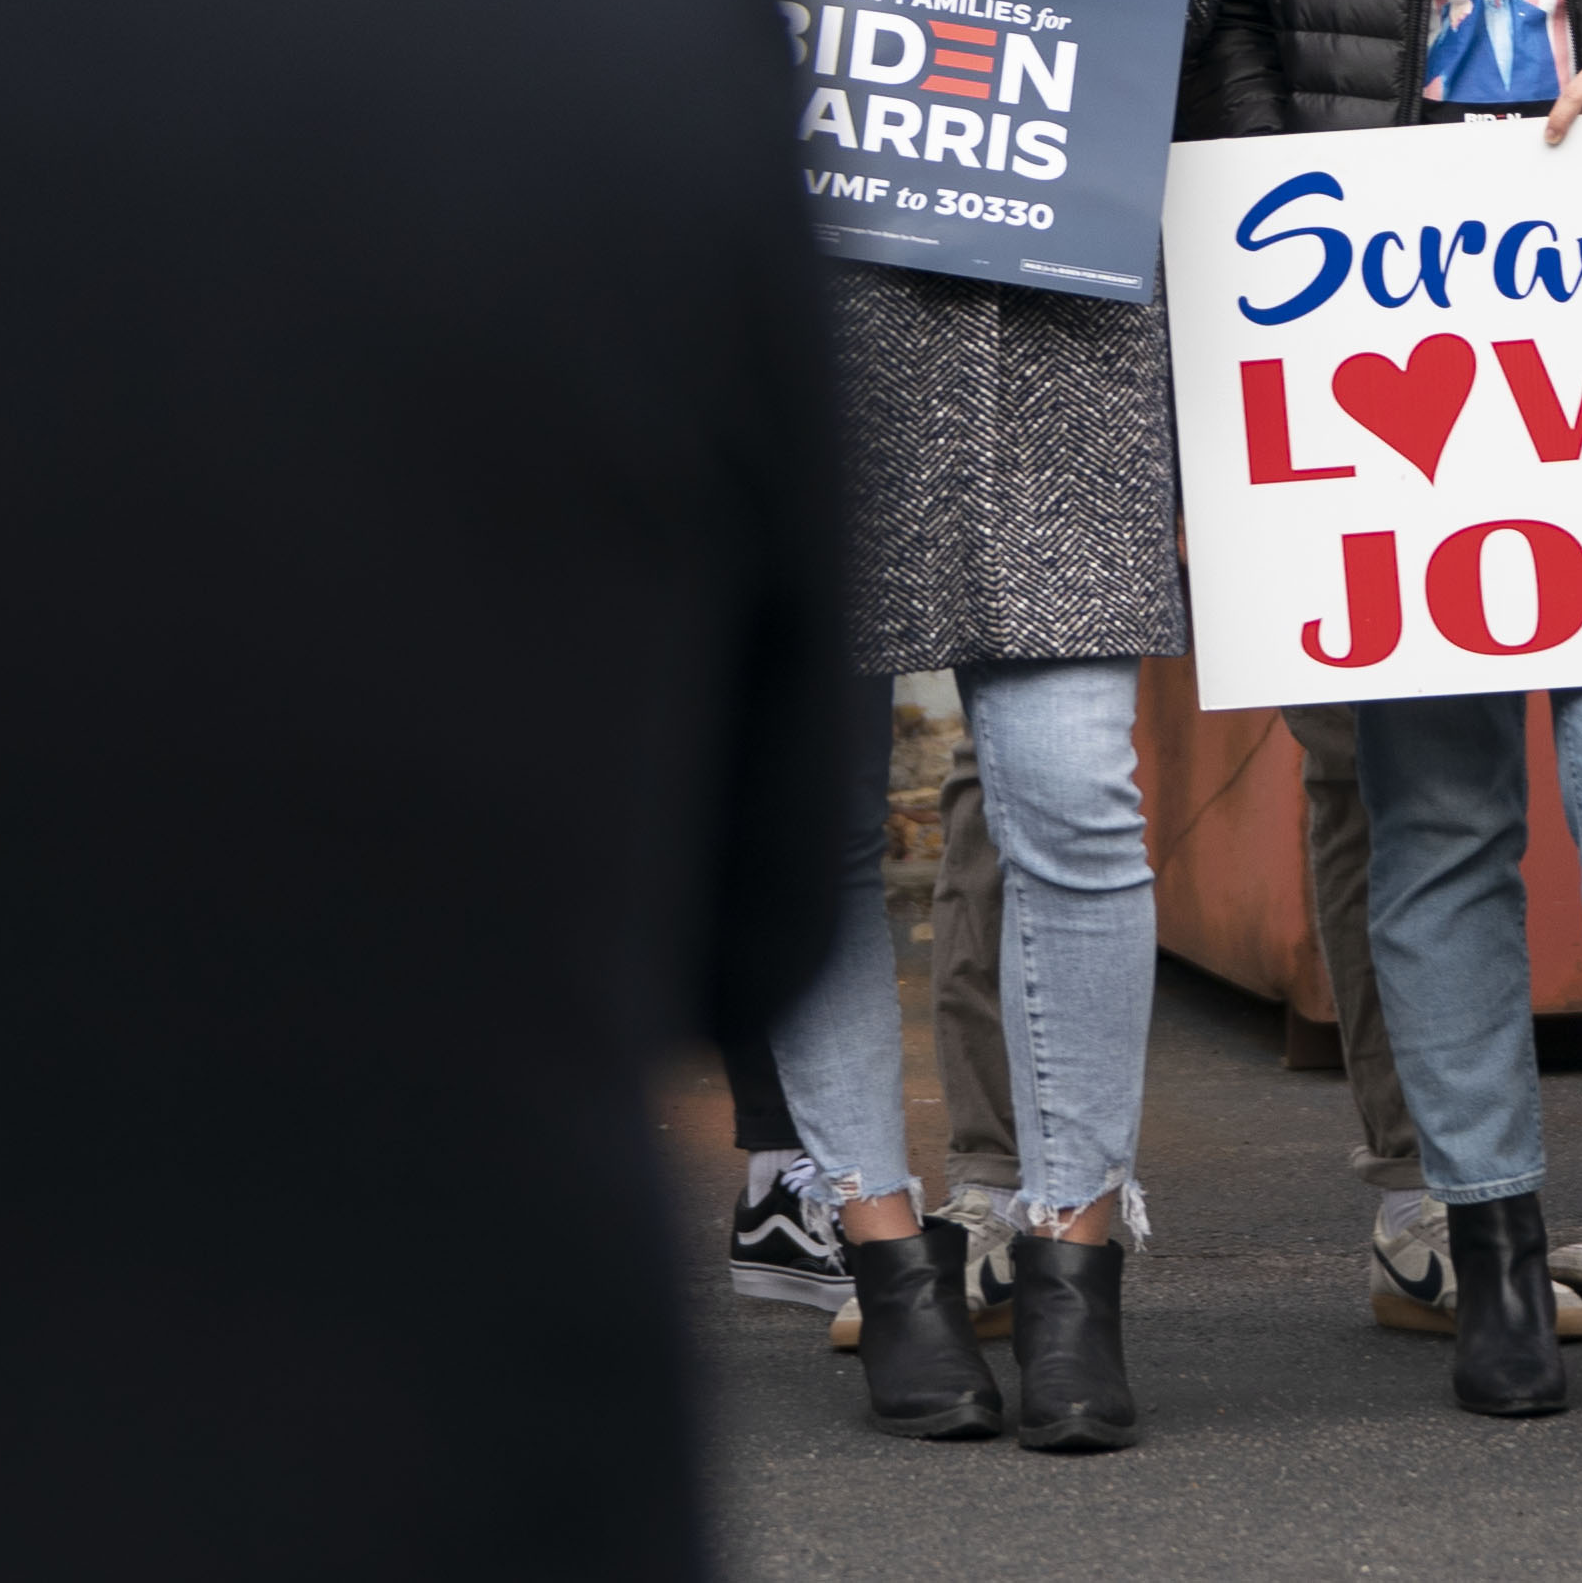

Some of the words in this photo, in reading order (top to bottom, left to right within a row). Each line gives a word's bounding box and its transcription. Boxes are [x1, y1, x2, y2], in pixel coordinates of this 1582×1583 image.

[1031, 7, 1072, 31] for
[797, 86, 1068, 181] ARRIS
[804, 169, 890, 203] VMF
[896, 185, 928, 211] to
[933, 188, 1054, 230] 30330
